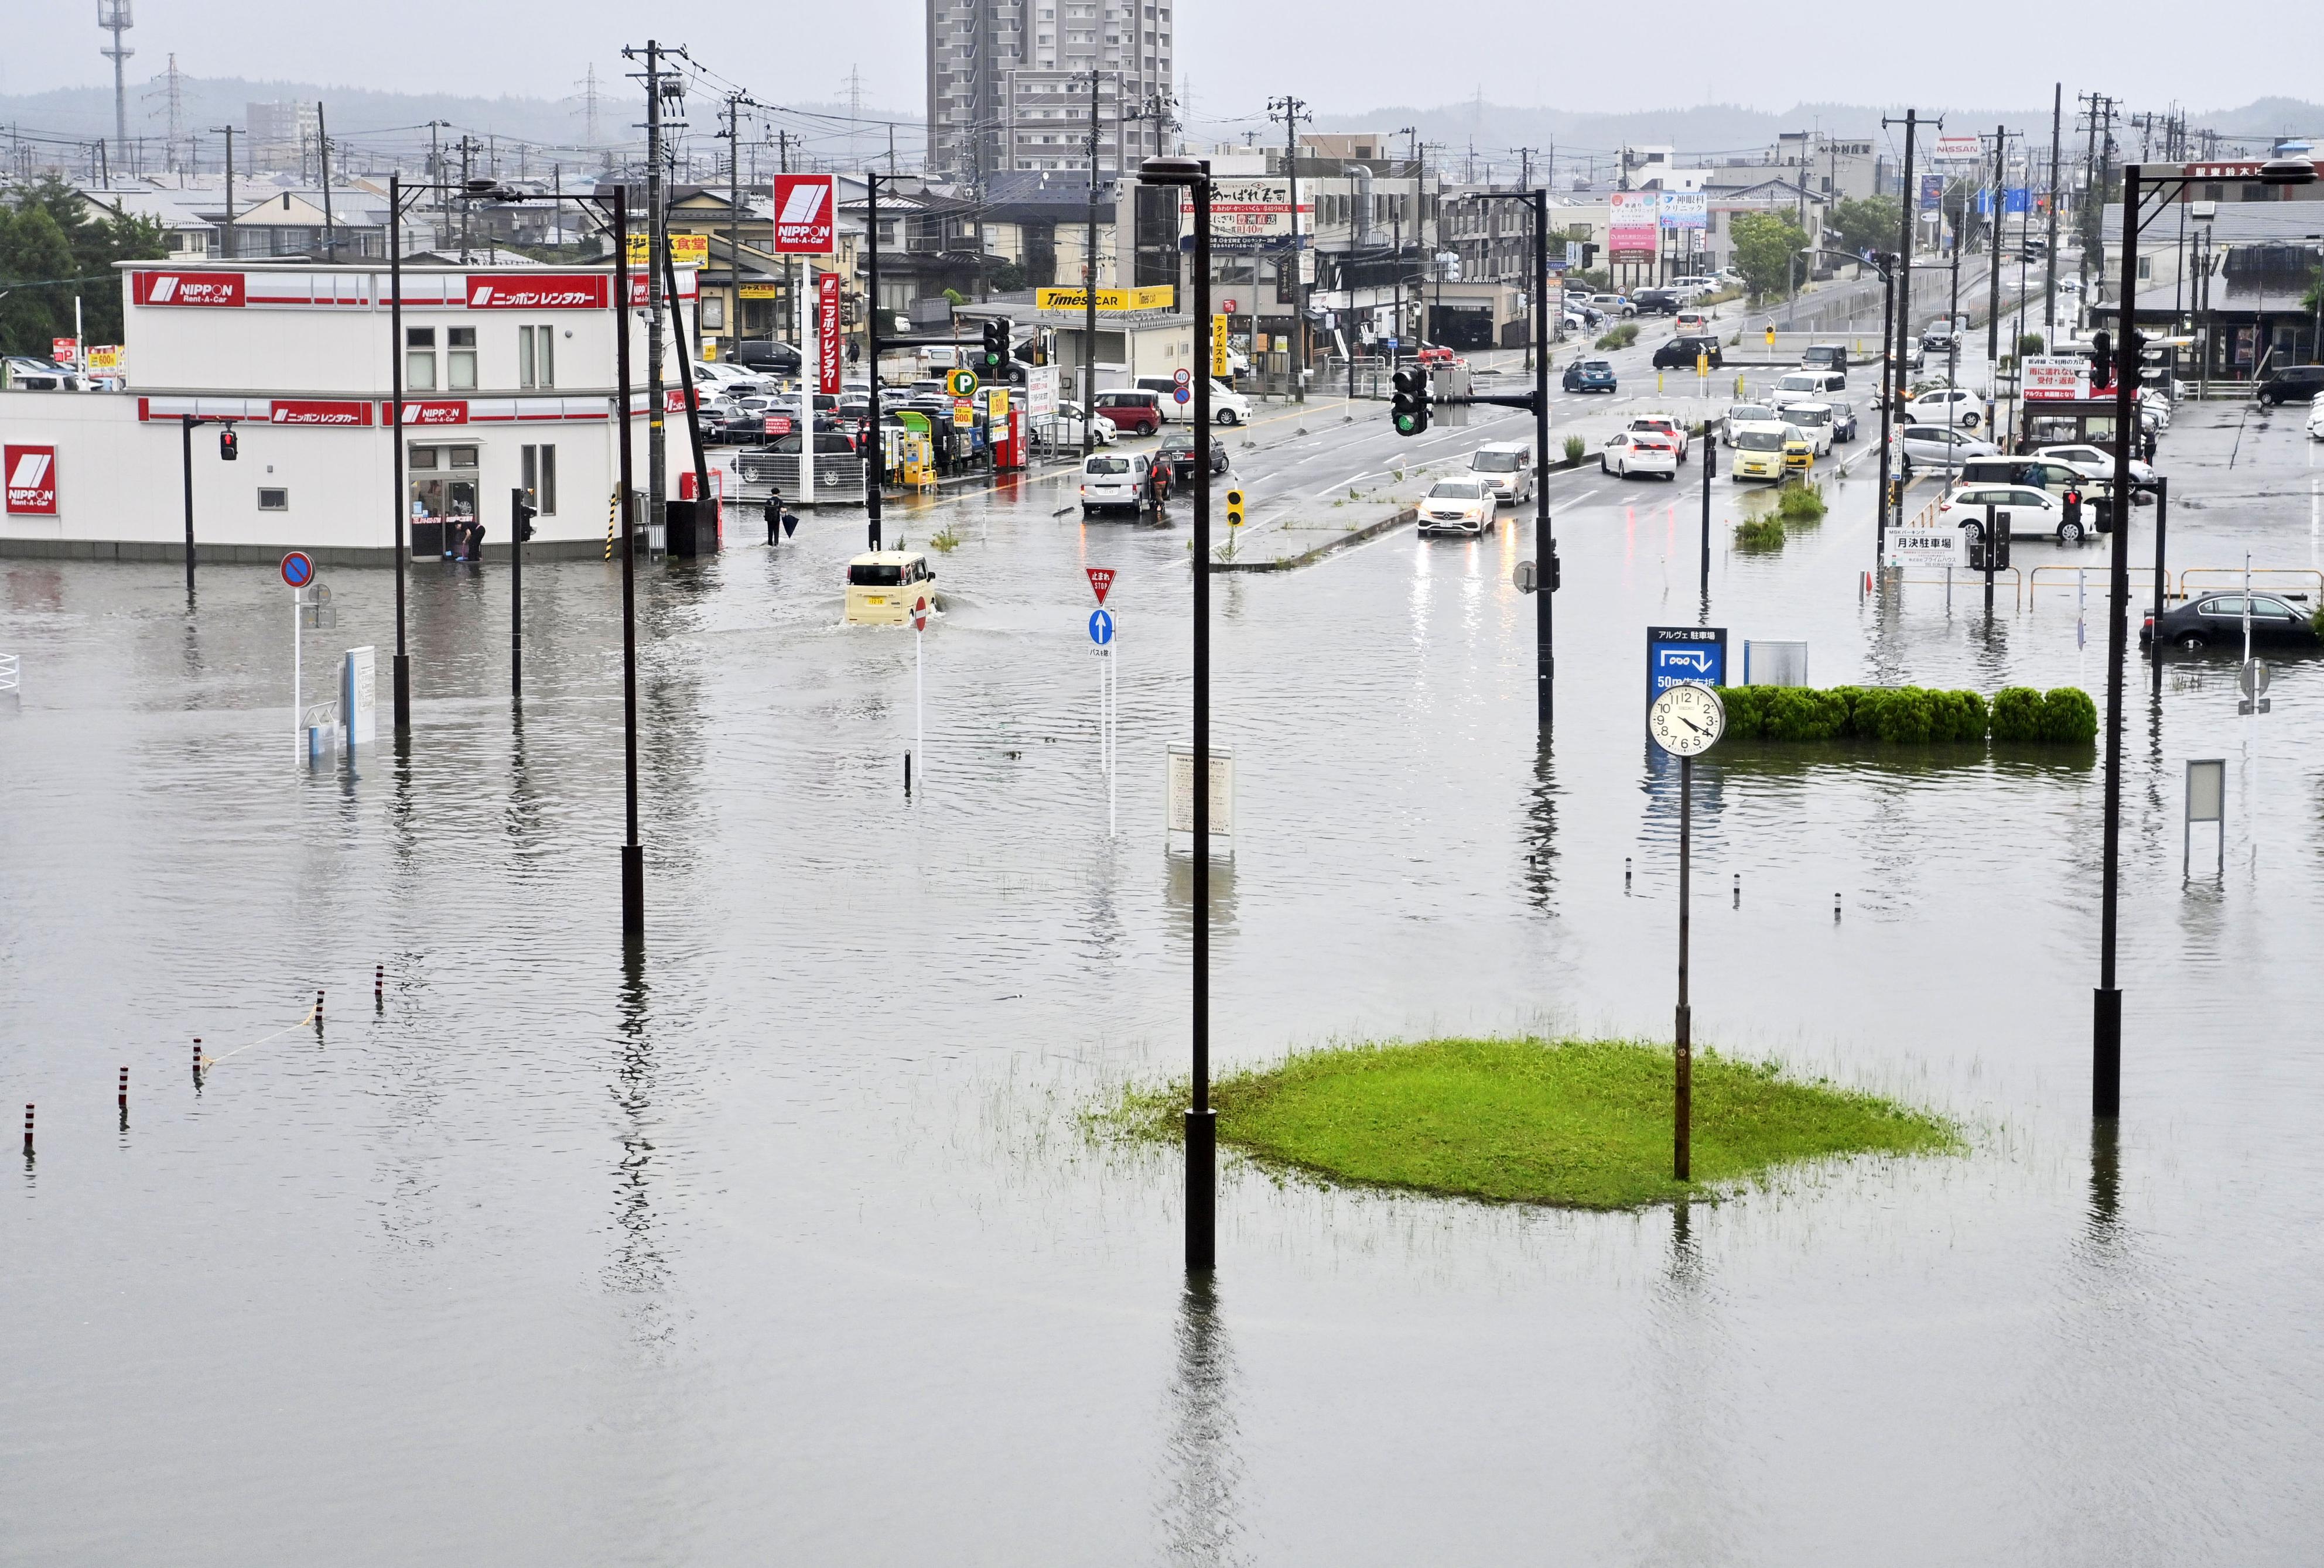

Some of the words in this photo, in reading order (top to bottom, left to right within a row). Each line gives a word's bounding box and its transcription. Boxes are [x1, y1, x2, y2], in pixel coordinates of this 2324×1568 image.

[1209, 182, 1286, 203] あっぱれ寿司
[1237, 214, 1276, 225] 豊洲直送
[778, 226, 830, 237] NIPPON
[180, 284, 233, 296] NIPPON
[634, 285, 648, 296] NIPPO
[492, 292, 594, 306] ニッポンレンタカー
[1047, 292, 1088, 305] Times
[1095, 296, 1117, 305] CAR
[823, 299, 835, 388] ニッポンレンタカー
[960, 375, 972, 392] P
[2037, 376, 2075, 385] 受付・返却
[287, 413, 358, 423] ニッポンレンタカー
[422, 409, 459, 417] NIPPON
[8, 489, 53, 500] NIPPON
[1898, 537, 1952, 549] 月決駐車場
[1092, 571, 1110, 581] 止まれ
[1690, 631, 1715, 639] 駐車場
[1681, 693, 1691, 703] 12
[1660, 704, 1670, 713] 10
[1703, 704, 1710, 714] 2
[1657, 715, 1665, 725] 9
[1706, 716, 1714, 726] 3
[1661, 726, 1669, 736] 8
[1701, 727, 1710, 737] 4
[1670, 735, 1677, 745] 7
[1680, 739, 1689, 749] 6
[1693, 736, 1701, 746] 5
